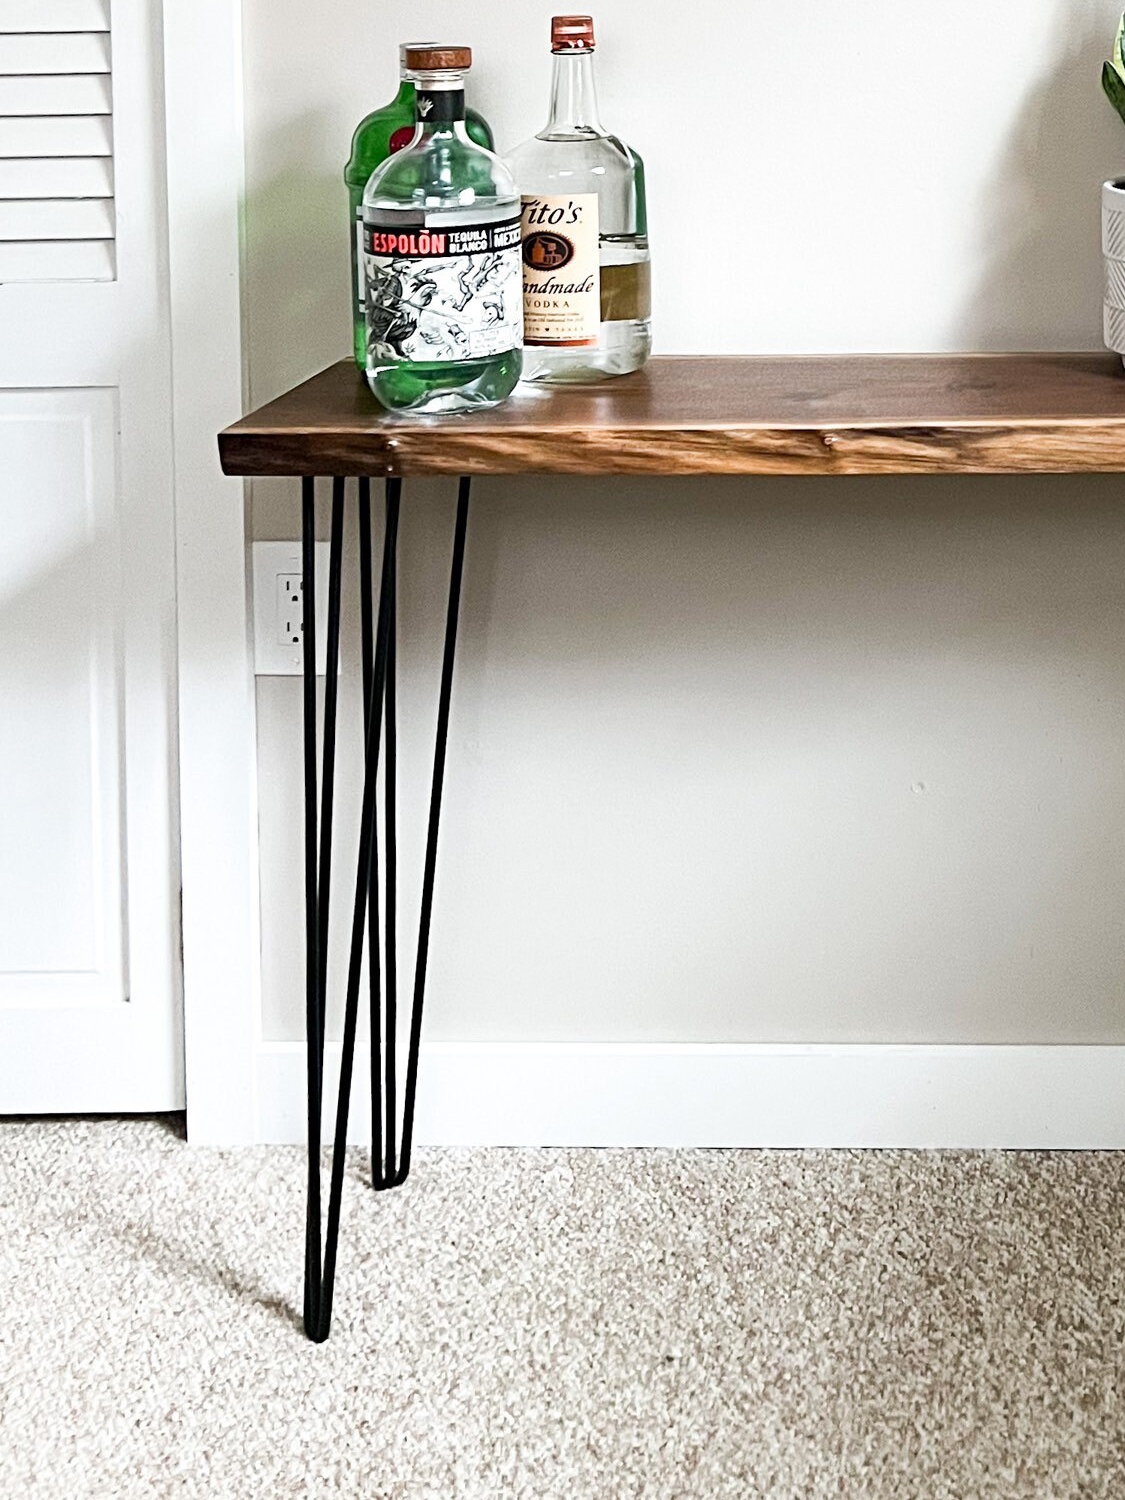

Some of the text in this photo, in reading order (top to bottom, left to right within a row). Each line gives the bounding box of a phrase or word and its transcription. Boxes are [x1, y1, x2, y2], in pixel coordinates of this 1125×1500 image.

[448, 229, 487, 243] TEQUILA
[449, 239, 488, 254] BLANCO
[522, 274, 595, 295] andmade
[525, 300, 570, 309] VODKA
